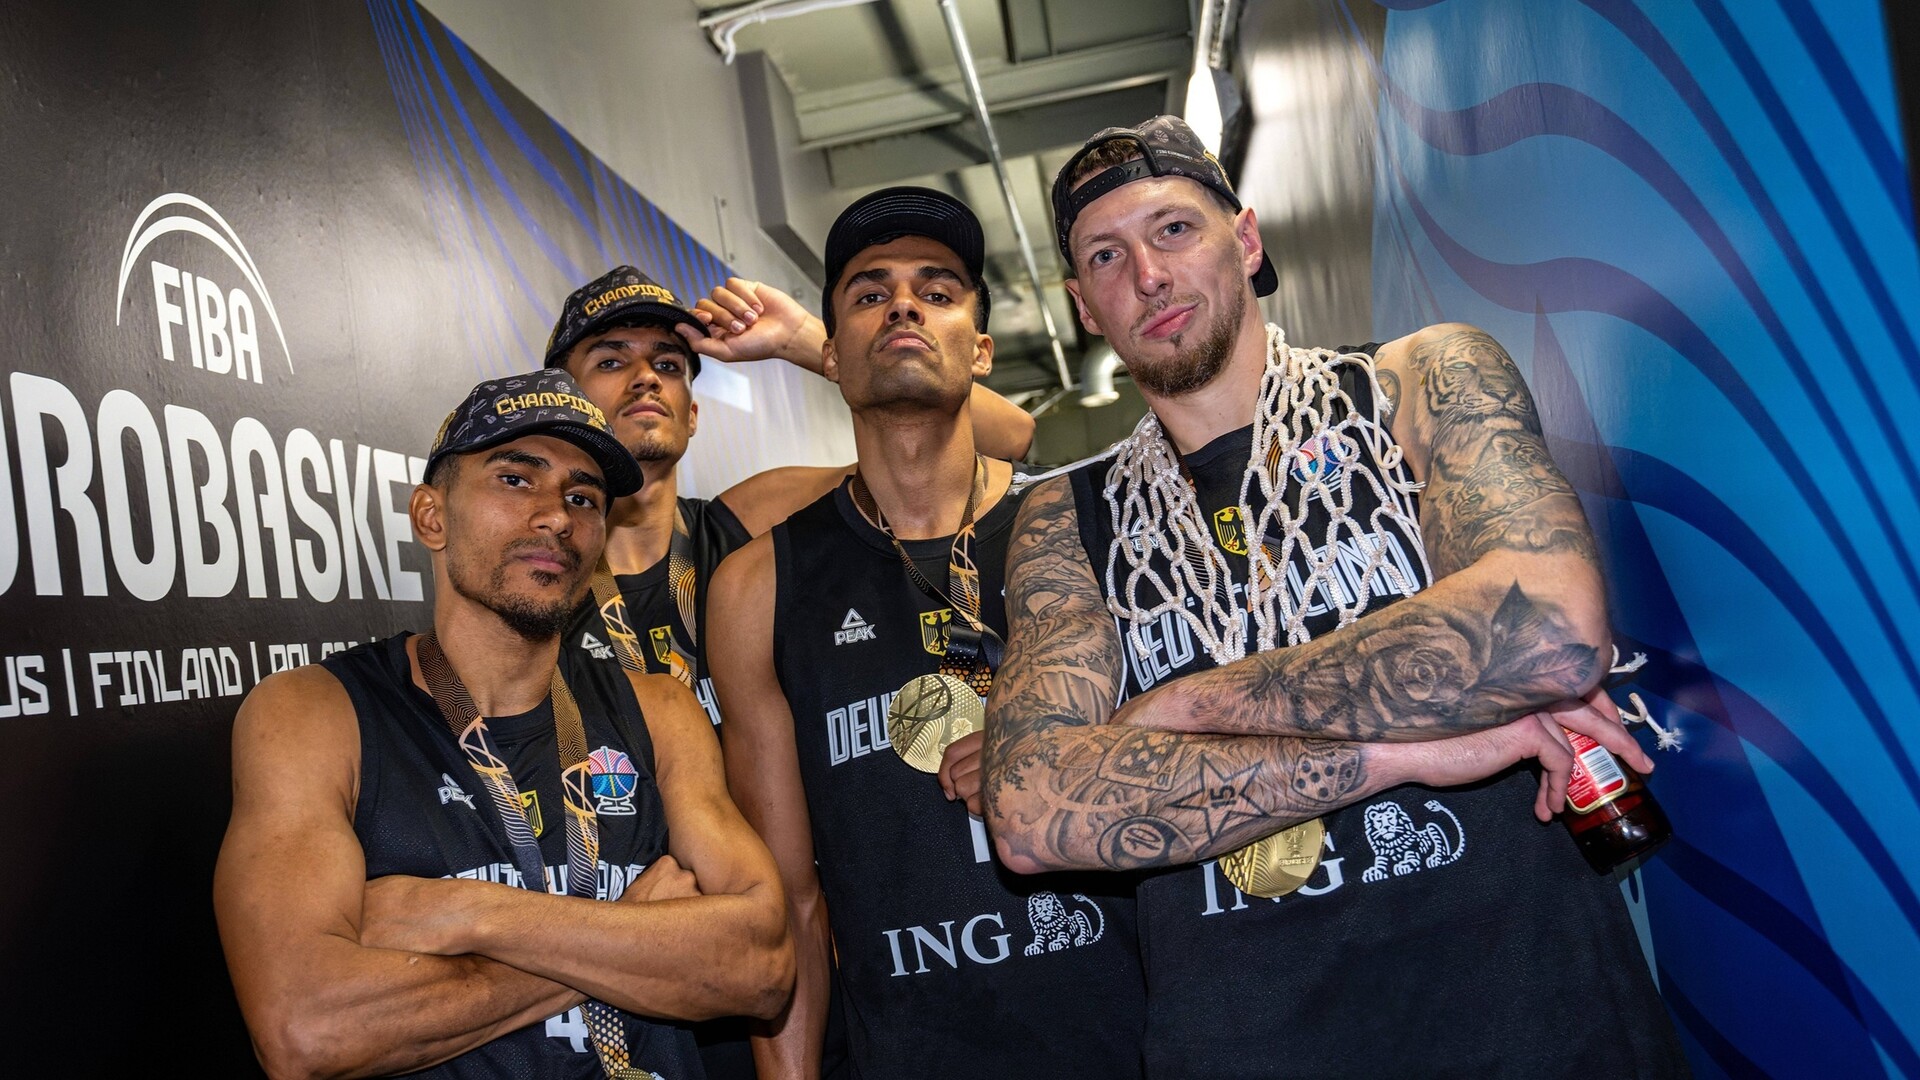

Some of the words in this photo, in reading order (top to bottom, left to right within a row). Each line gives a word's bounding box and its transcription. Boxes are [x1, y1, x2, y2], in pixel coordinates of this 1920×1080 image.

[584, 284, 675, 316] CHAMPIONS
[151, 261, 263, 384] FIBA
[496, 392, 607, 426] CHAMPIONS
[0, 371, 427, 603] ROBASKE
[834, 624, 876, 646] PEAK
[89, 647, 243, 709] FINLAND
[1210, 785, 1236, 809] 15
[1125, 828, 1161, 850] 10
[882, 912, 1012, 977] ING
[545, 1005, 589, 1053] 4
